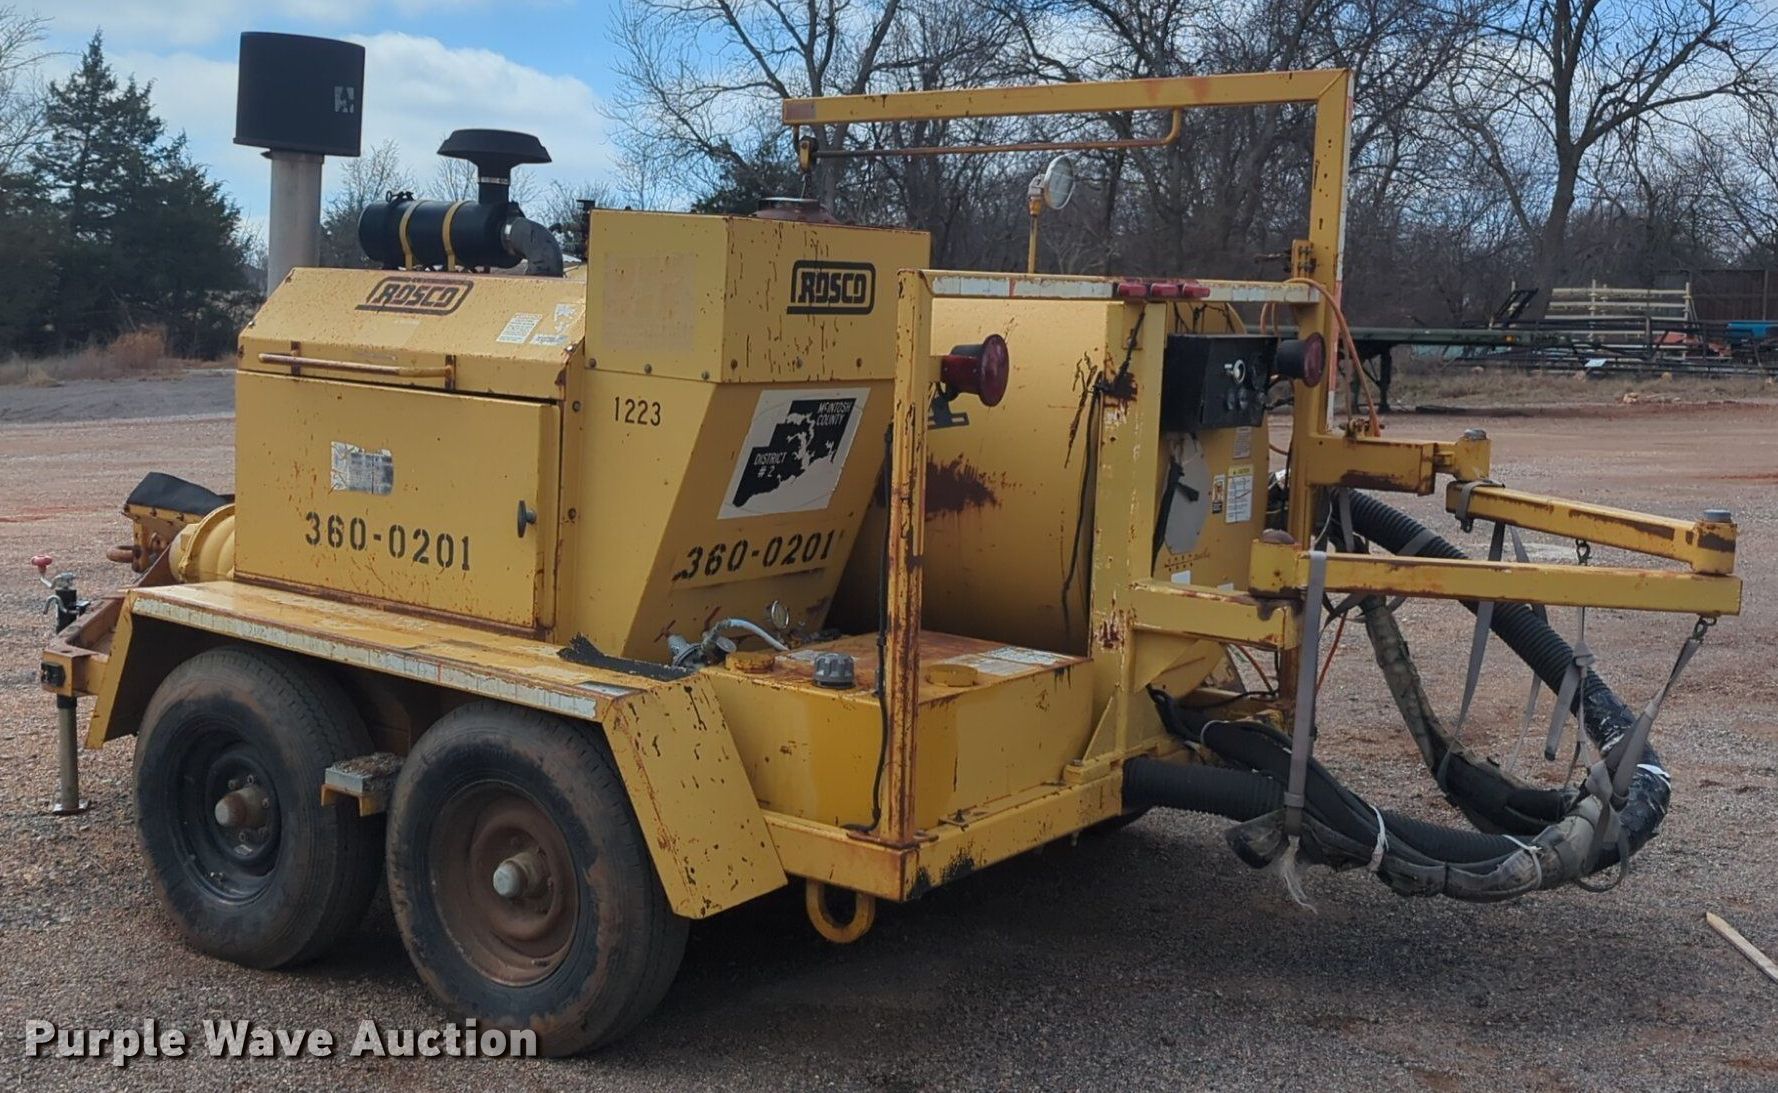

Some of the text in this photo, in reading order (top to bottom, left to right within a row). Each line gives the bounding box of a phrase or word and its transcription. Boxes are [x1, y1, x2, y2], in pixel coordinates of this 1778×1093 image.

[370, 283, 460, 307] ROSCO
[797, 271, 867, 304] ROSCO
[615, 396, 661, 426] 1223
[816, 414, 845, 426] COUNTY
[754, 452, 787, 465] DISTRICT
[305, 511, 470, 571] 360-0201
[676, 529, 835, 580] 360-0201
